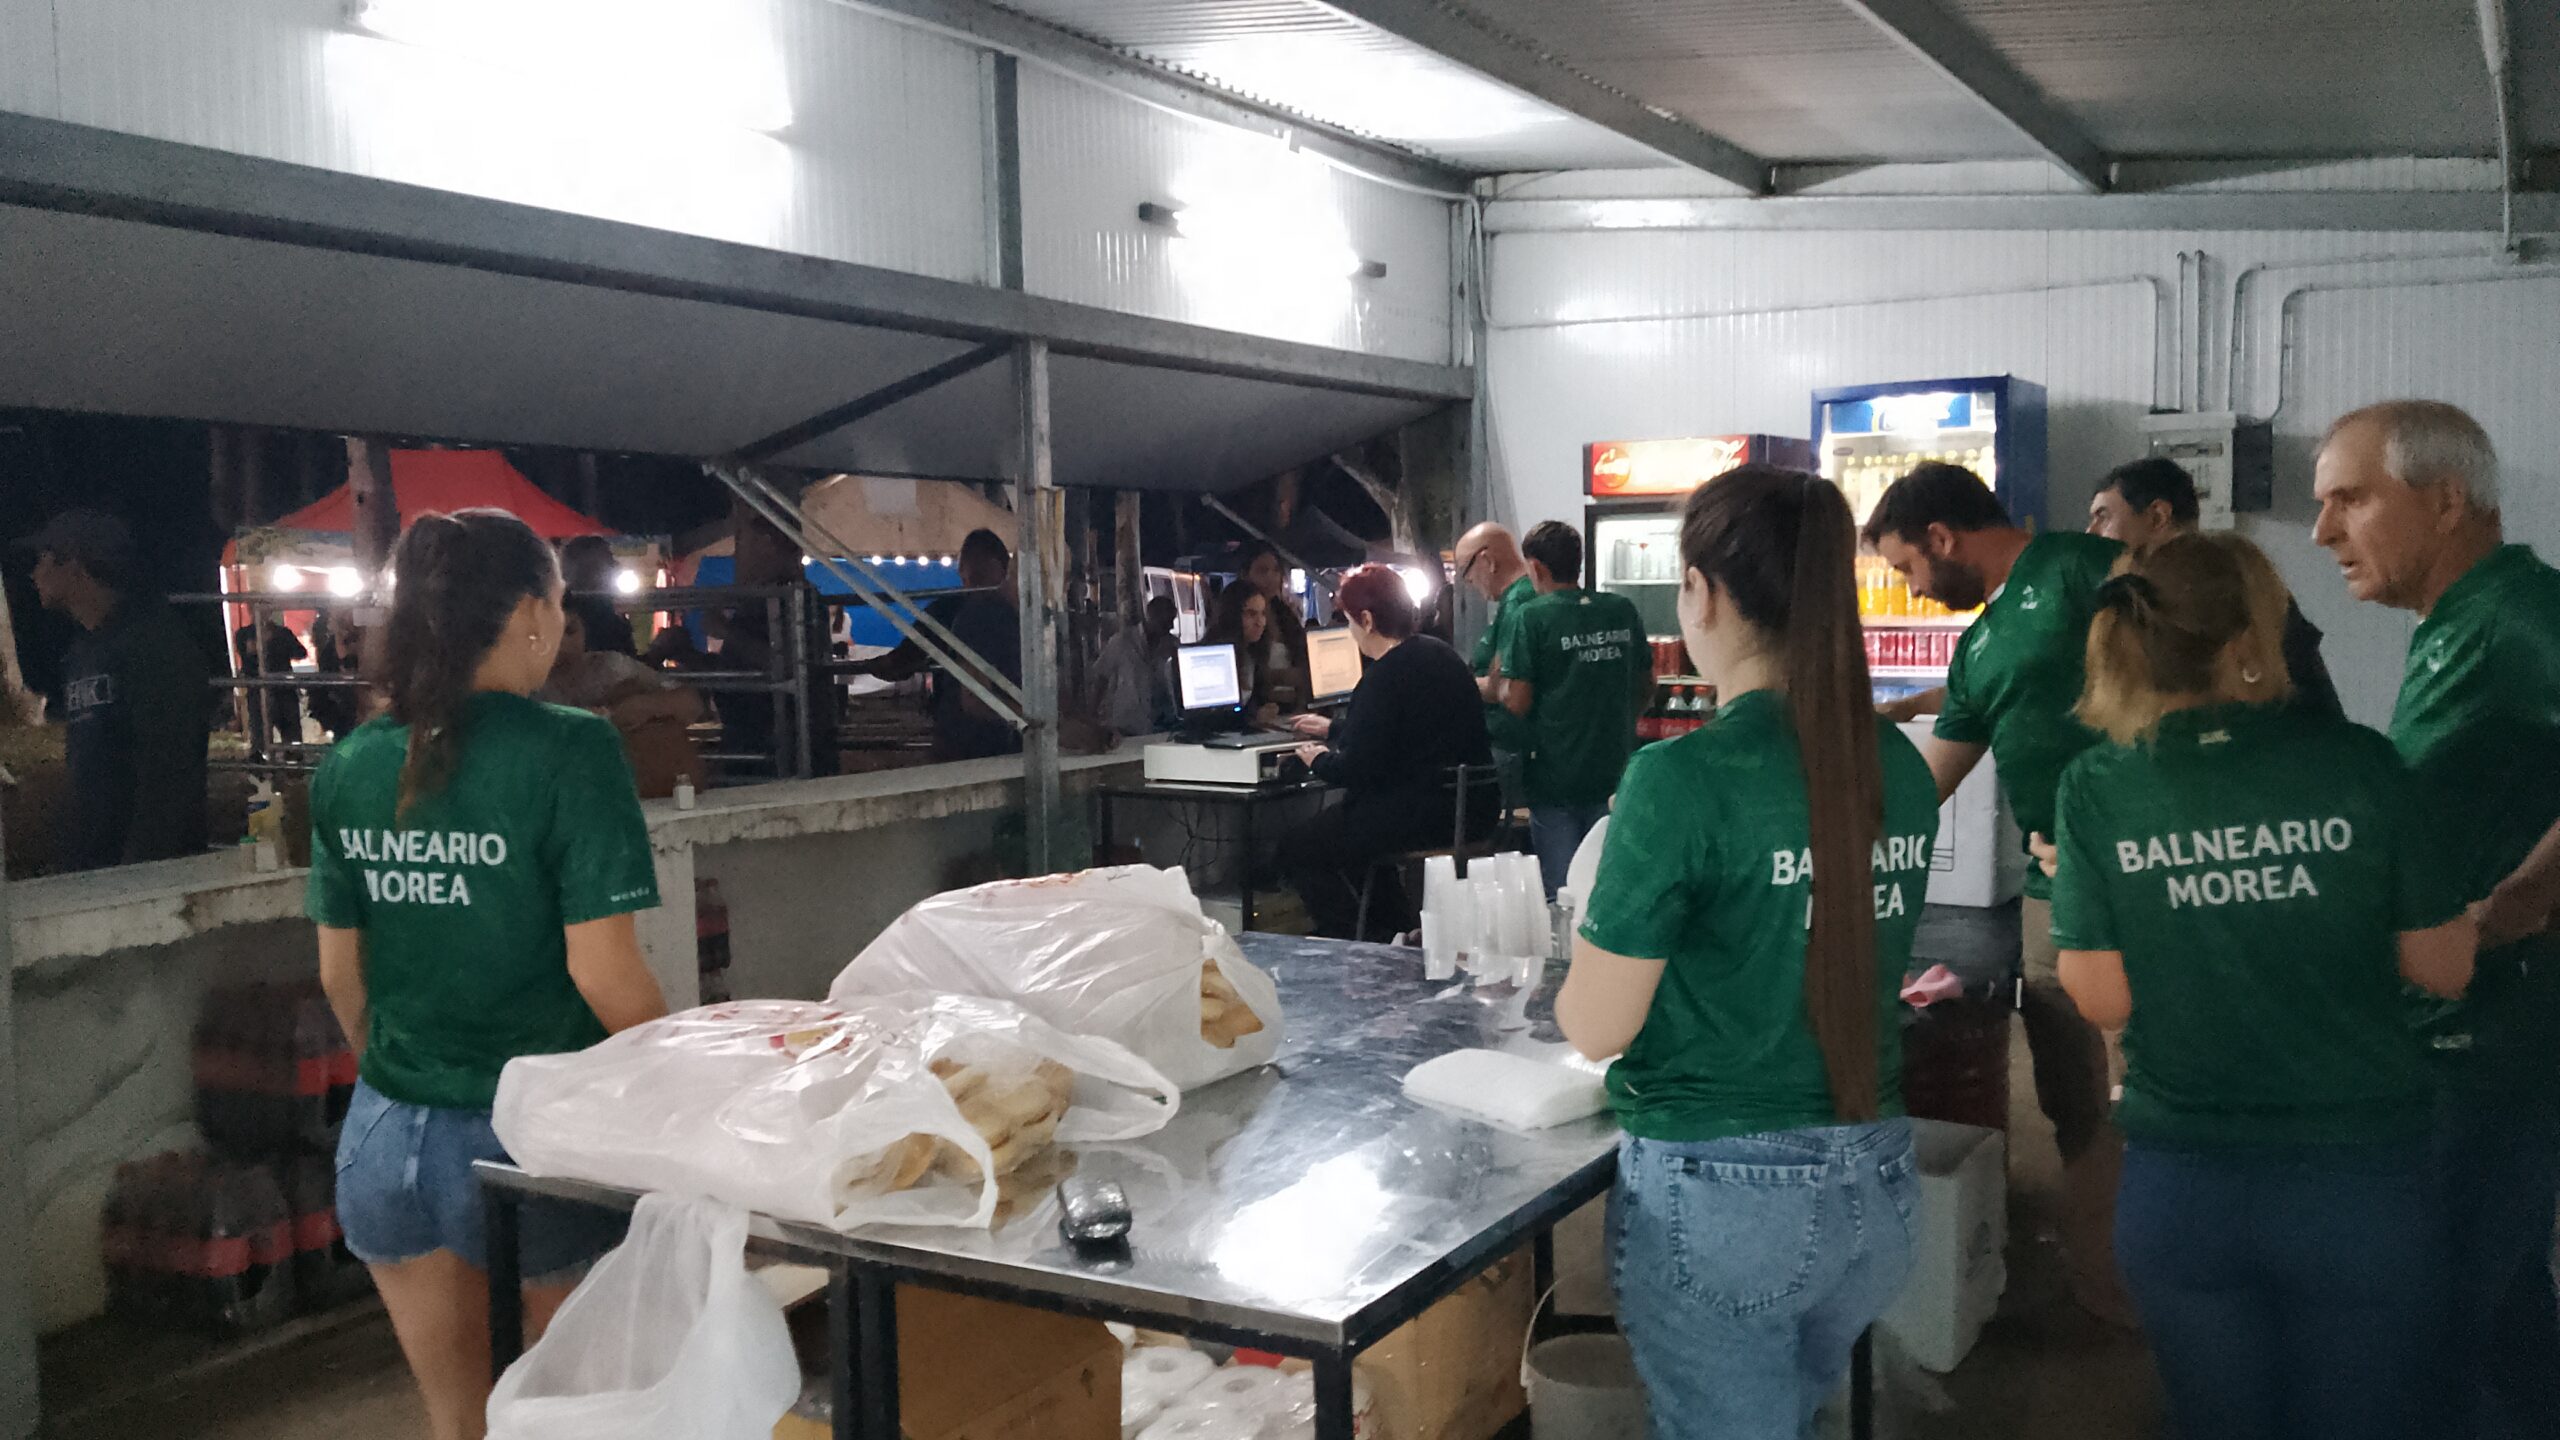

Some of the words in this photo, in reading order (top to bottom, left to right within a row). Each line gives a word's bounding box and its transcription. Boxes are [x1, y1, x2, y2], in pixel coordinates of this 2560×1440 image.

[1771, 834, 1927, 886] BAARIO
[2116, 817, 2353, 873] BALNEARIO
[2166, 864, 2319, 909] MOREA
